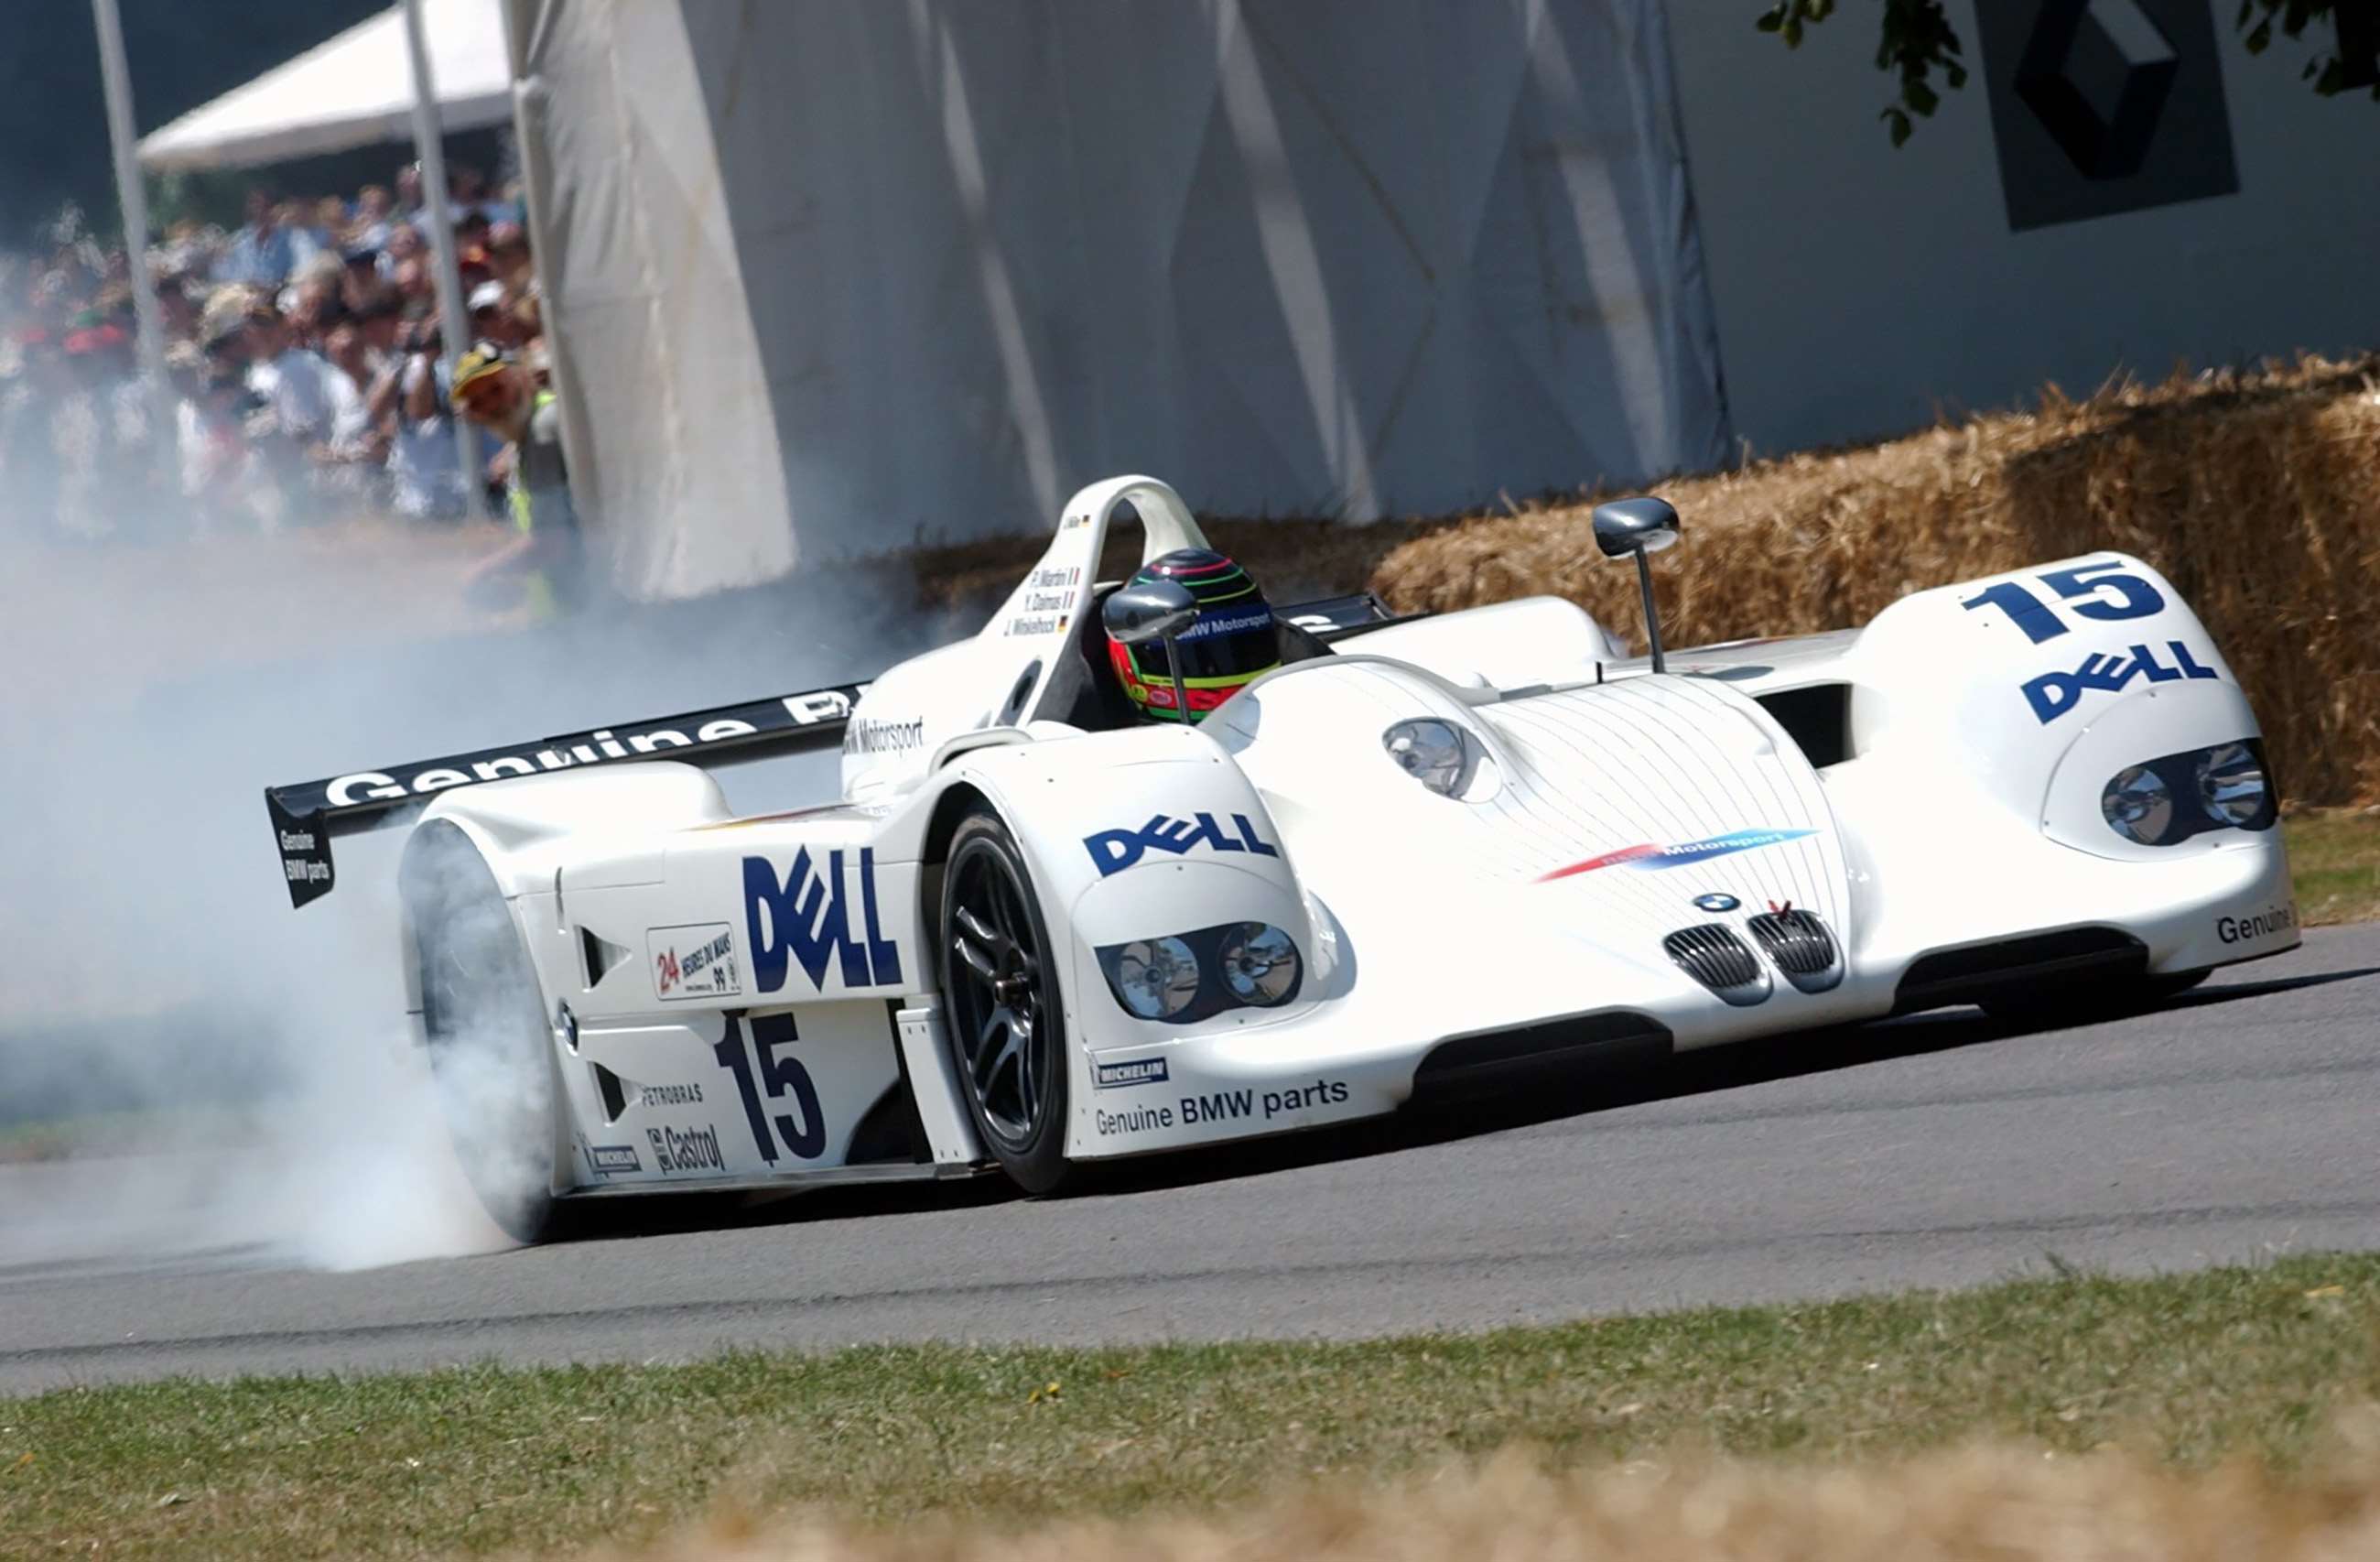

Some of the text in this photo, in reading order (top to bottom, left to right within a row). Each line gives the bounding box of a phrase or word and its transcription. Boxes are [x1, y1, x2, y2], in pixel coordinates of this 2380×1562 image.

[1961, 561, 2165, 645] 15
[2020, 641, 2219, 725] DELL
[1083, 812, 1281, 878] DELL
[1663, 832, 1786, 857] Motorsport
[741, 843, 903, 993] DELL
[657, 947, 679, 994] 24
[712, 1009, 827, 1164] 15
[1098, 1061, 1165, 1083] MICHELIN
[1098, 1079, 1350, 1135] Genuine BMW parts
[665, 1123, 726, 1172] Castrol
